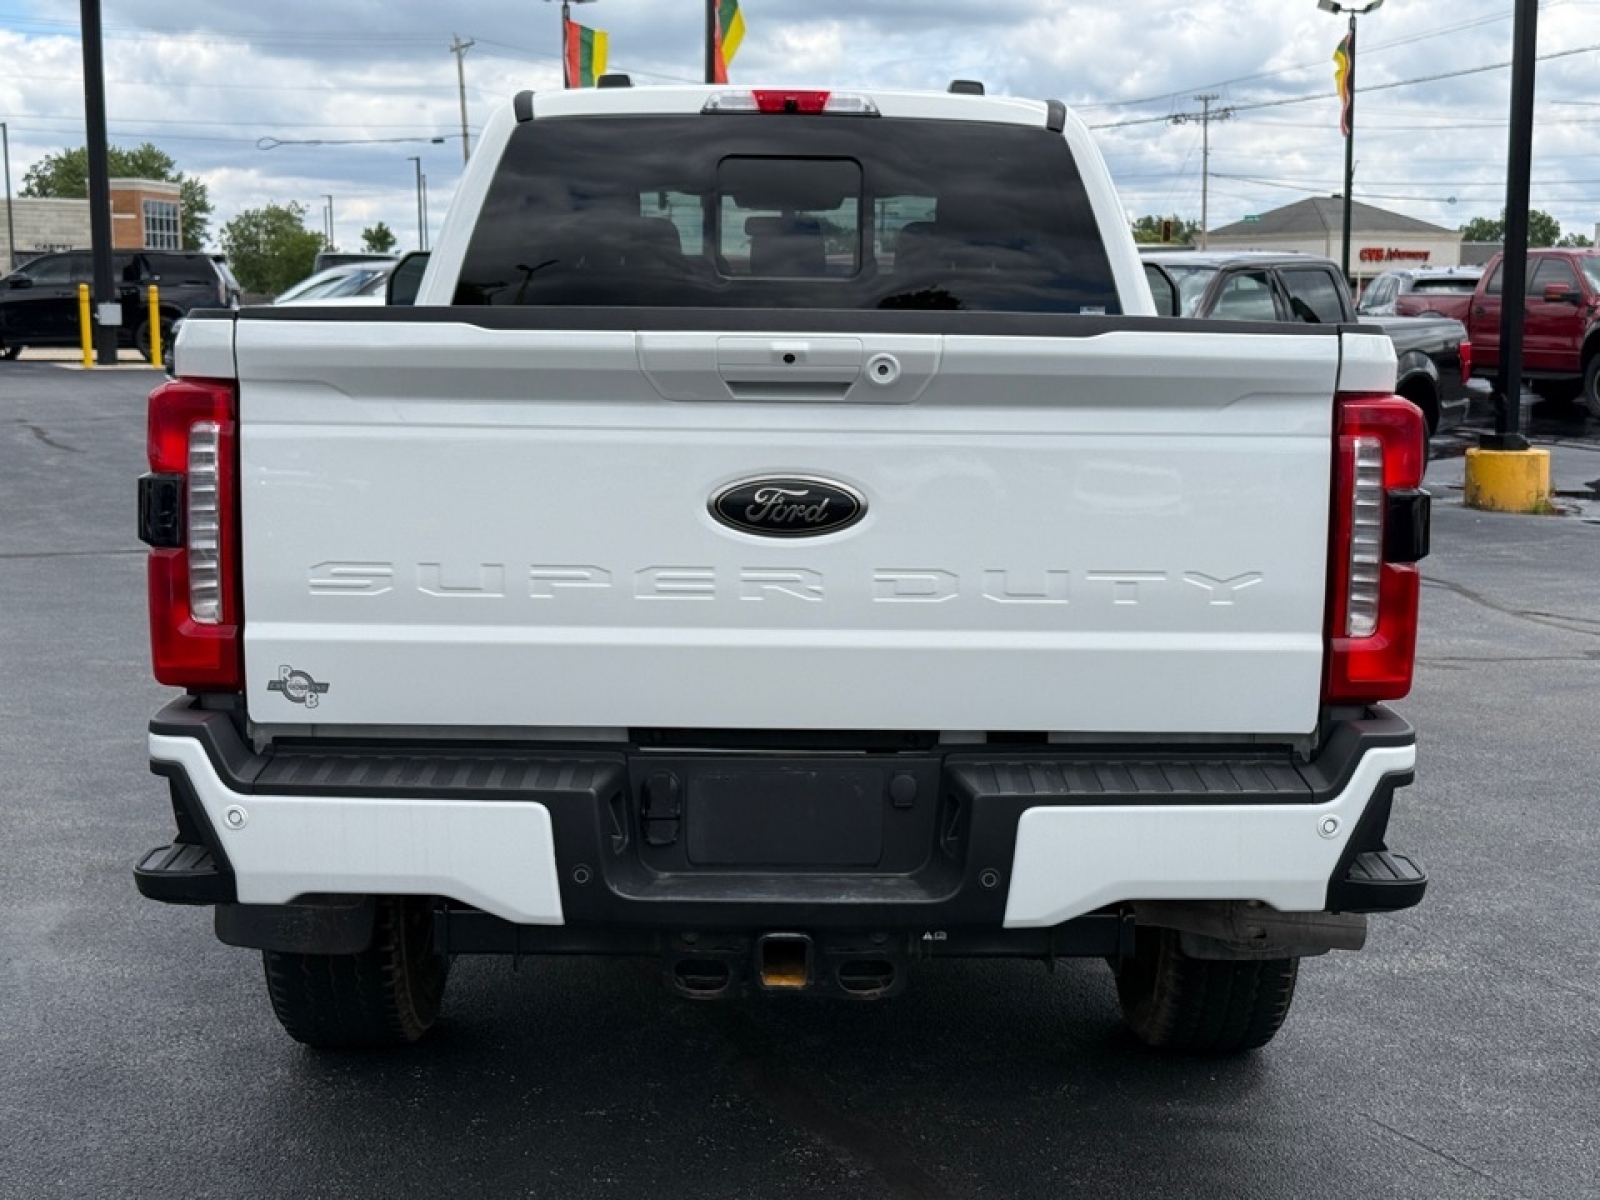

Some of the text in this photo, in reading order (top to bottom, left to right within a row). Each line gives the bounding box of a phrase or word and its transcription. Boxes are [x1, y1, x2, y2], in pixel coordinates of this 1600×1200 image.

[745, 488, 829, 522] Ford
[309, 561, 1263, 605] SUPER DUTY
